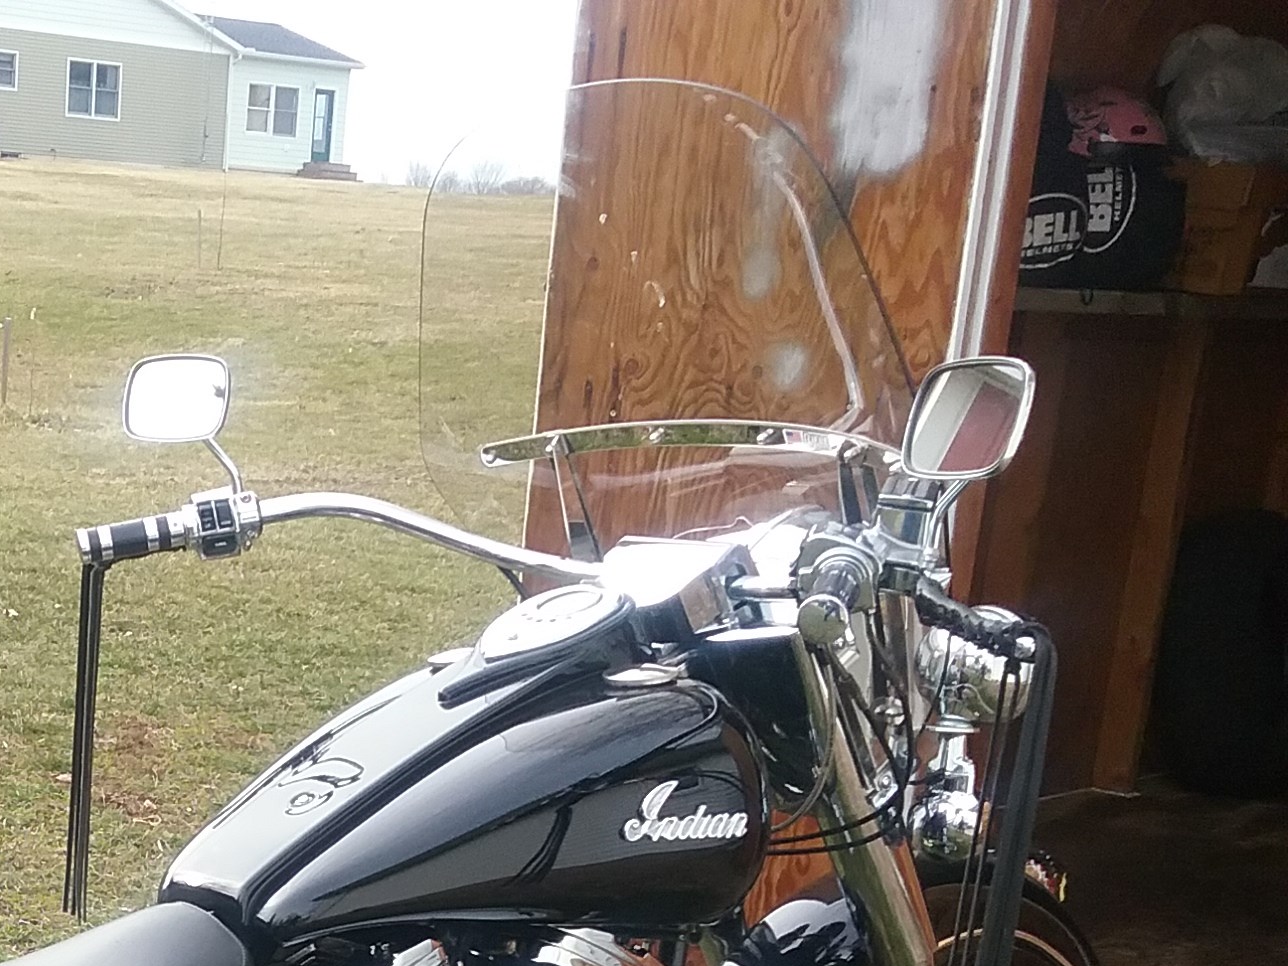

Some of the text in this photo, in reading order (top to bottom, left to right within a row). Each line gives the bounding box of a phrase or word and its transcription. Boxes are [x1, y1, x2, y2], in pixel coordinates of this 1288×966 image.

[1087, 167, 1113, 232] BEL
[1114, 166, 1124, 221] HELMET
[624, 780, 749, 842] Indian
